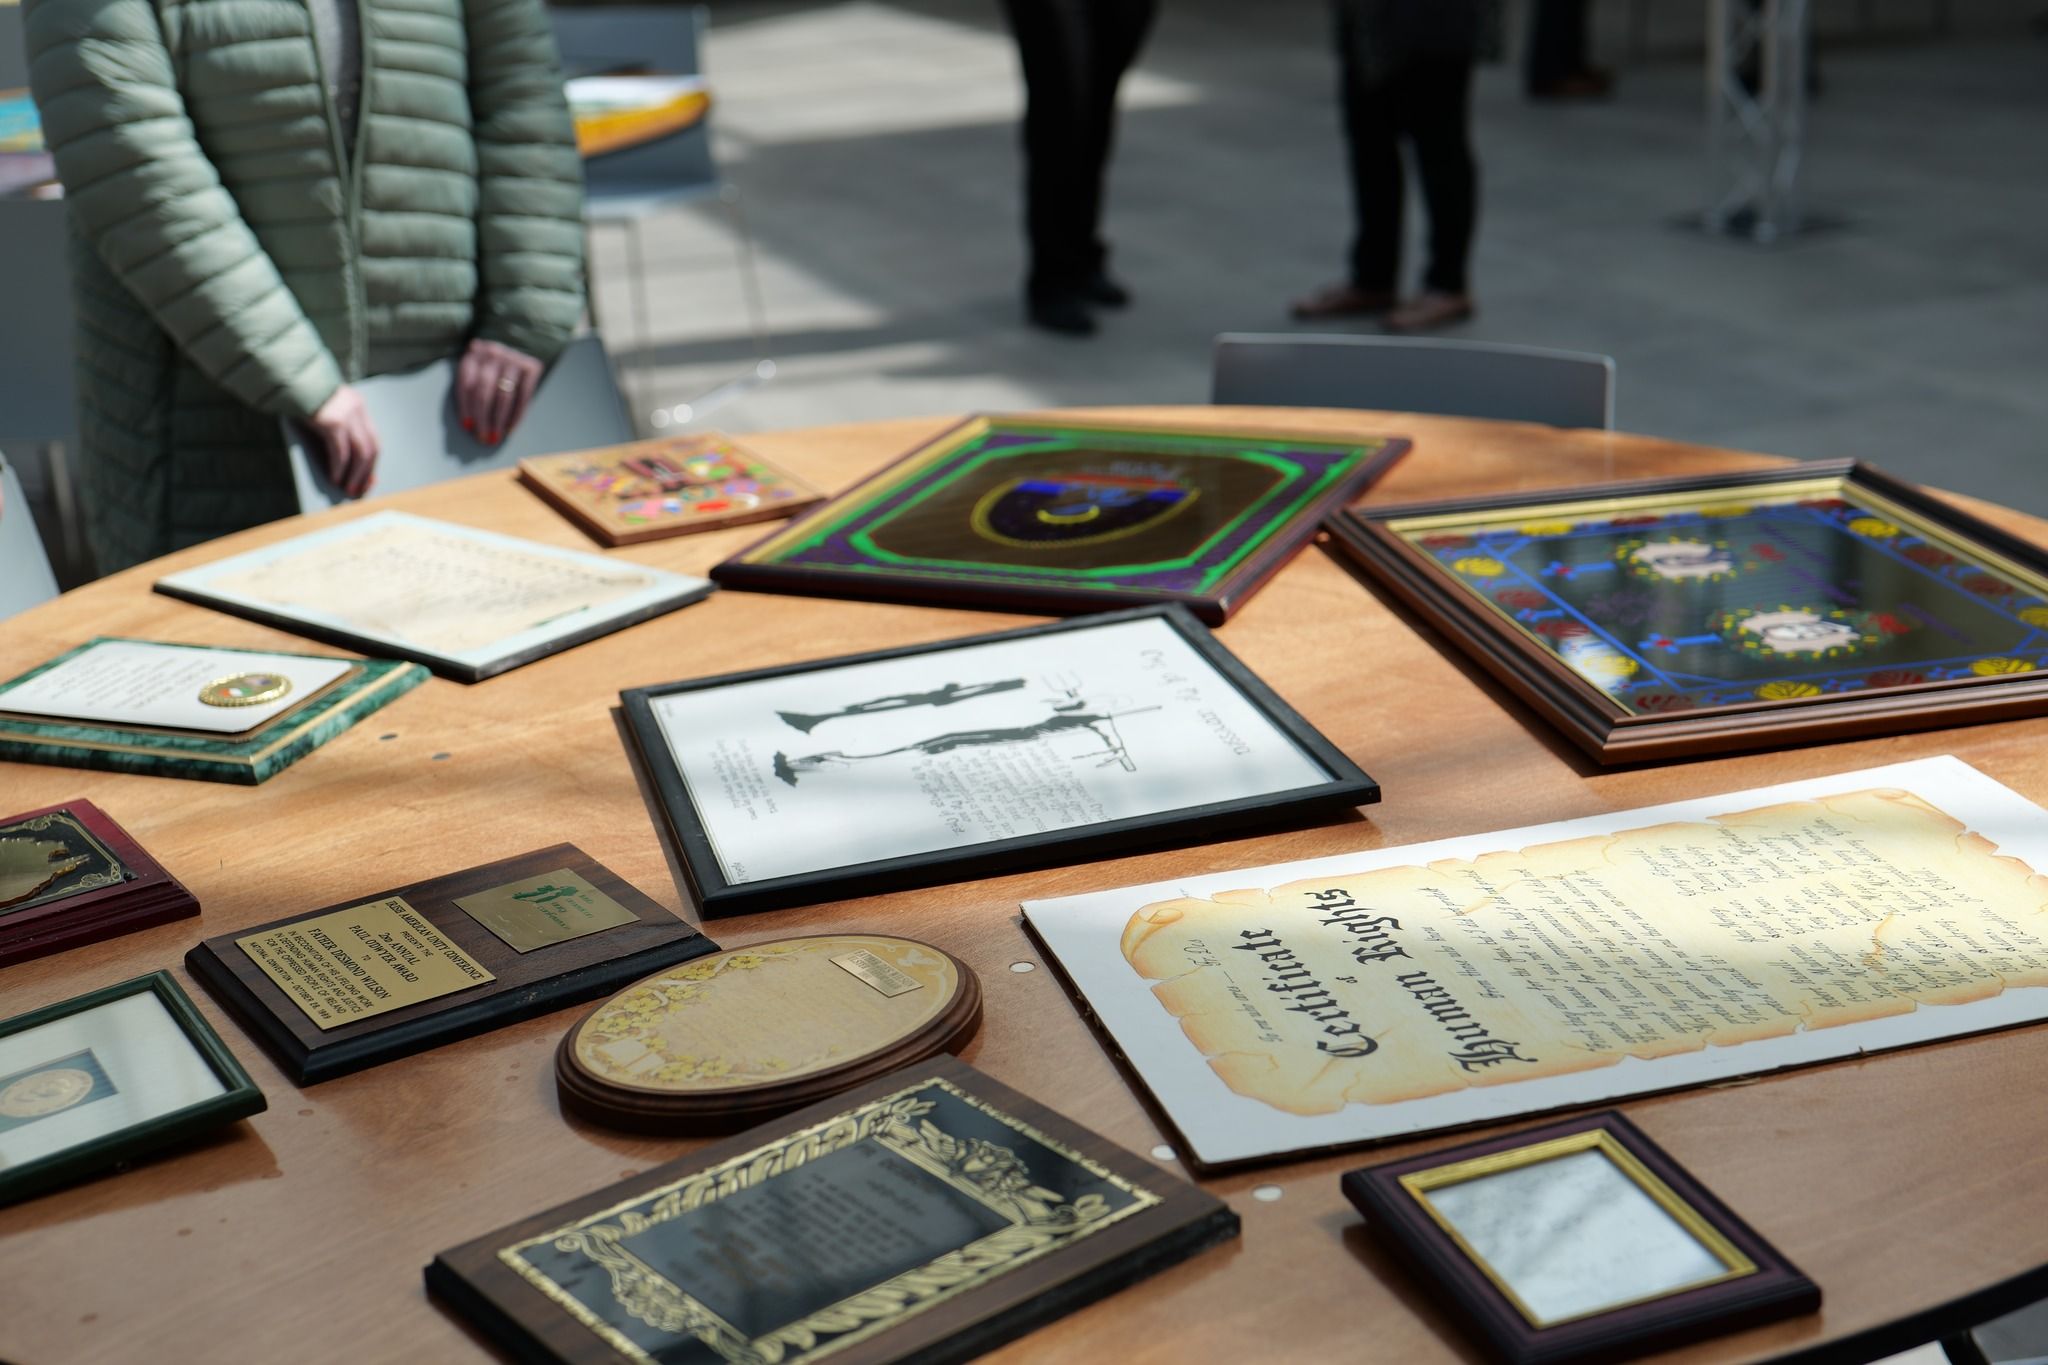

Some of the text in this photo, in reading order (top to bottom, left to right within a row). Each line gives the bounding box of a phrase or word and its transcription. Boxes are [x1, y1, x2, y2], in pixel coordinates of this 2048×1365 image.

[384, 899, 484, 980] IRISH AMERICAN UNITY CONFERENCE
[399, 930, 434, 957] PRESENTS THE
[1182, 938, 1212, 954] Des
[307, 927, 391, 999] FATHER DESMOND WILSON
[348, 924, 371, 940] PAUL
[389, 963, 419, 982] AWARD
[360, 953, 372, 961] TO
[388, 942, 420, 965] ANNUAL
[1515, 950, 1544, 962] not
[249, 941, 268, 959] NATIONAL
[265, 958, 293, 981] CONVENTION
[291, 984, 314, 1002] OCTOBER
[263, 937, 278, 947] FOR
[272, 945, 287, 955] THE
[280, 954, 307, 975] OPPRESSED
[302, 974, 323, 990] PEOPLE
[324, 996, 347, 1014] IRELAND
[278, 936, 306, 959] DEFENDING
[300, 958, 321, 973] HUMAN
[315, 972, 336, 988] RIGHTS
[330, 986, 346, 997] AND
[340, 996, 363, 1013] JUSTICE
[293, 935, 325, 962] RECOGNITION
[327, 967, 340, 976] HIS
[334, 974, 360, 995] LIFELONG
[356, 994, 374, 1008] WORK
[1508, 966, 1532, 977] the
[1561, 960, 1584, 971] the
[1306, 888, 1536, 1072] Human Rights
[1334, 975, 1358, 984] of
[1525, 979, 1554, 991] for
[1576, 972, 1607, 984] for
[1235, 929, 1377, 1058] Certificate
[1563, 985, 1597, 1008] because
[1560, 1010, 1595, 1027] they
[1615, 1002, 1647, 1020] they
